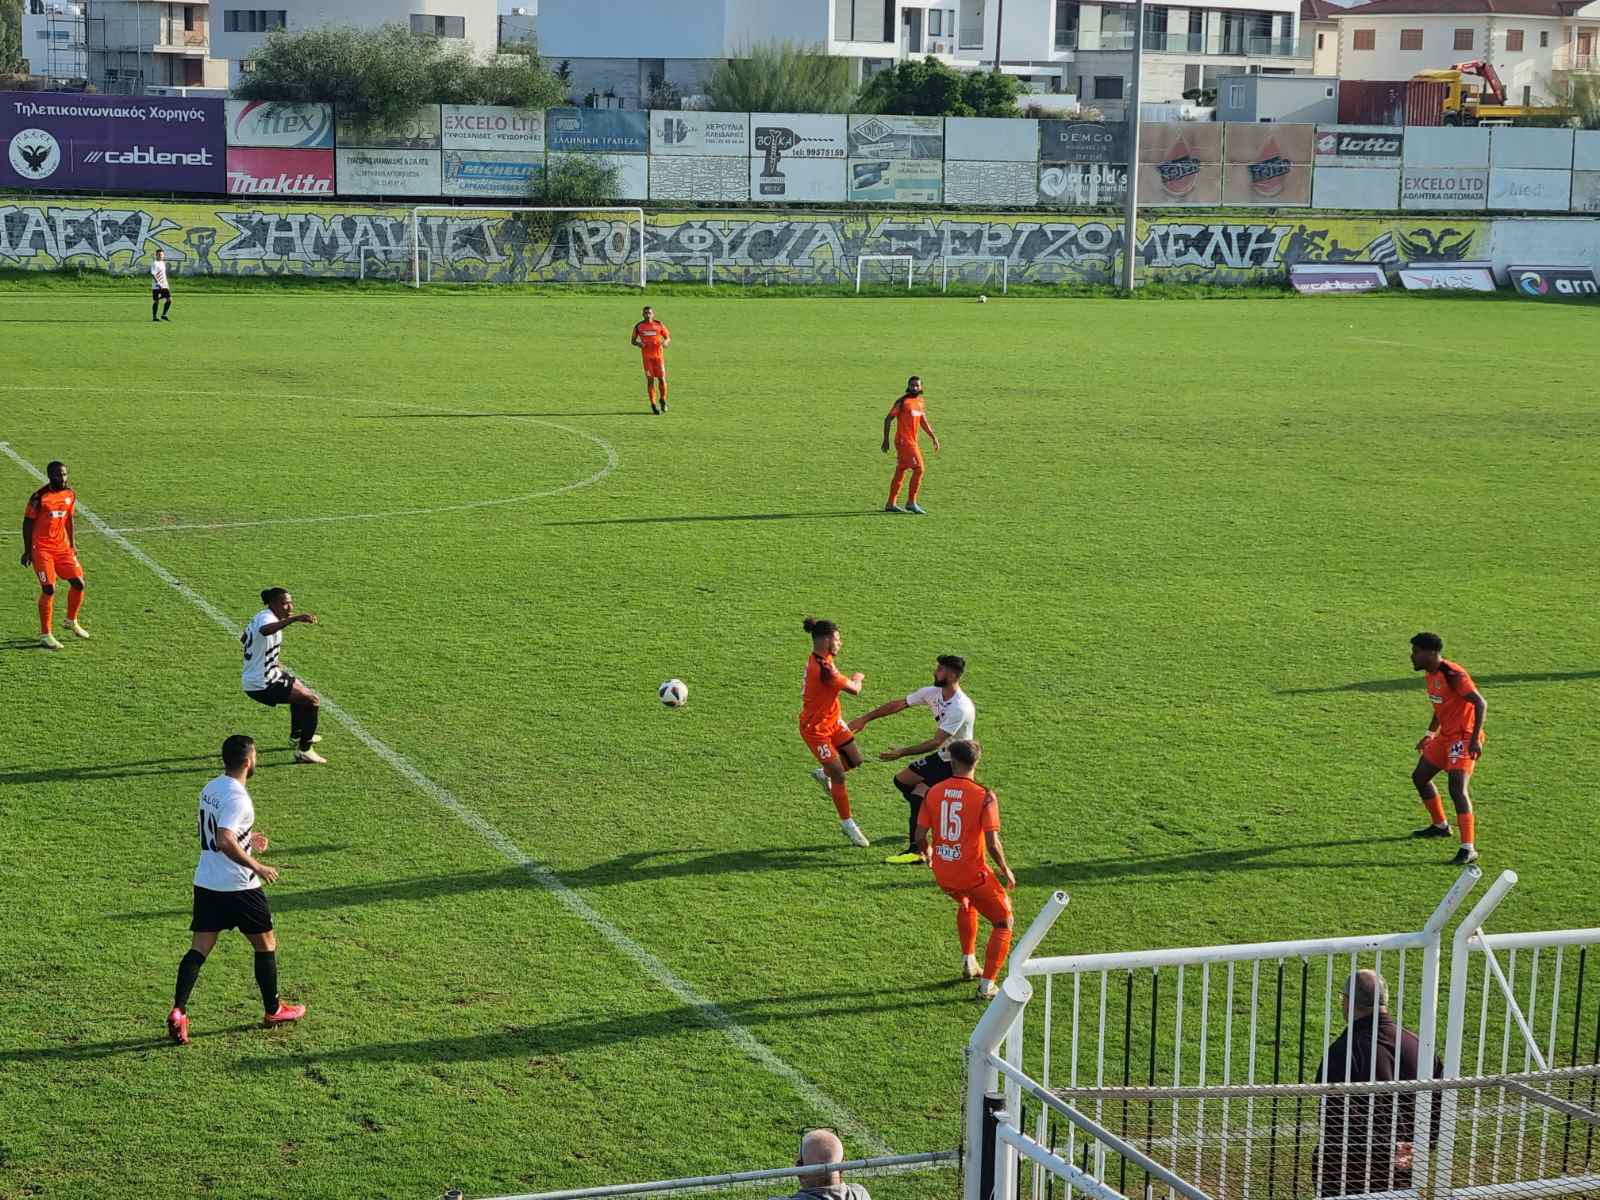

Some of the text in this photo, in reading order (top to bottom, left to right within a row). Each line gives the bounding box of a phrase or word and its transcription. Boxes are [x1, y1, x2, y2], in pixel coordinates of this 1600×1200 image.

[14, 101, 205, 126] Τηλεπικοινωνιακός Χορηγός
[445, 114, 508, 131] EXCELO
[511, 117, 543, 132] LTD
[1059, 132, 1113, 142] DEMCO
[105, 146, 214, 167] cablenet
[1404, 176, 1484, 191] EXCELO LTD
[940, 799, 962, 841] 15
